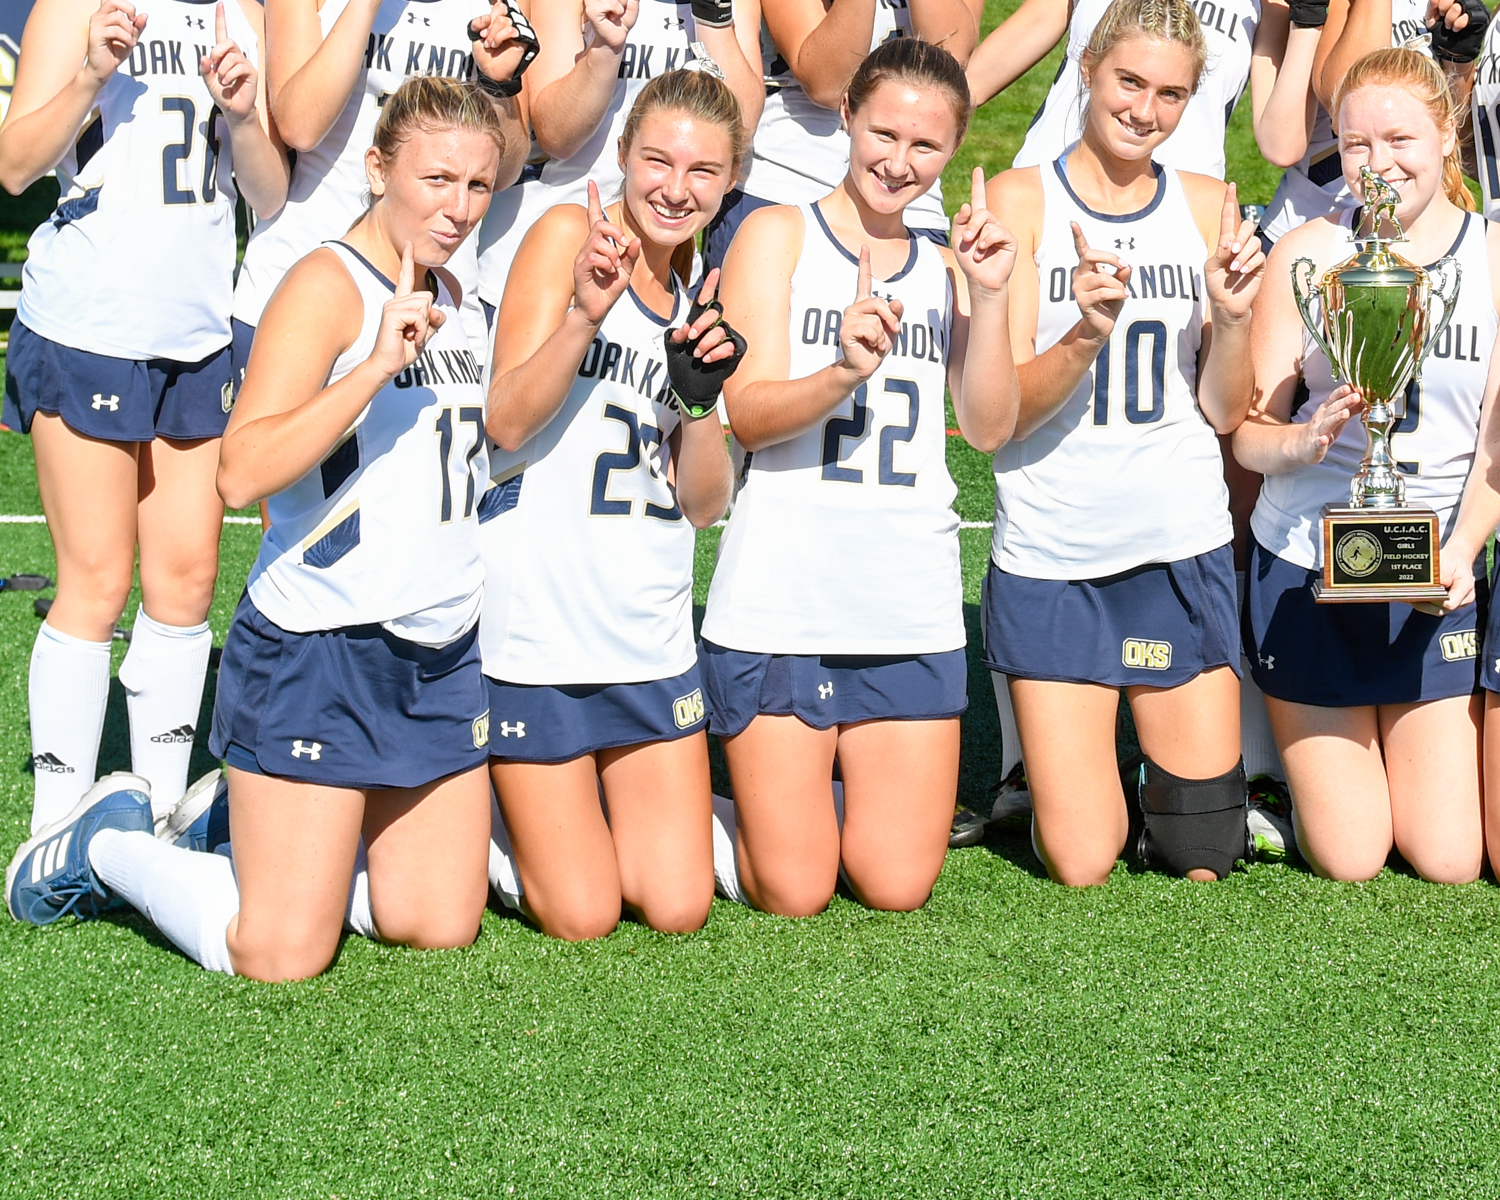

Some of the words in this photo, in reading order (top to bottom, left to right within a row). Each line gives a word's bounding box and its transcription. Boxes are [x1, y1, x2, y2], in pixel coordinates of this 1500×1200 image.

[129, 40, 185, 77] OAK
[618, 43, 654, 79] AK
[578, 337, 639, 388] OAK
[1091, 317, 1168, 428] 10
[821, 374, 918, 487] 22
[434, 404, 485, 525] 17
[1396, 542, 1416, 550] GIRLS
[1122, 640, 1171, 669] OKS
[35, 761, 76, 774] didas
